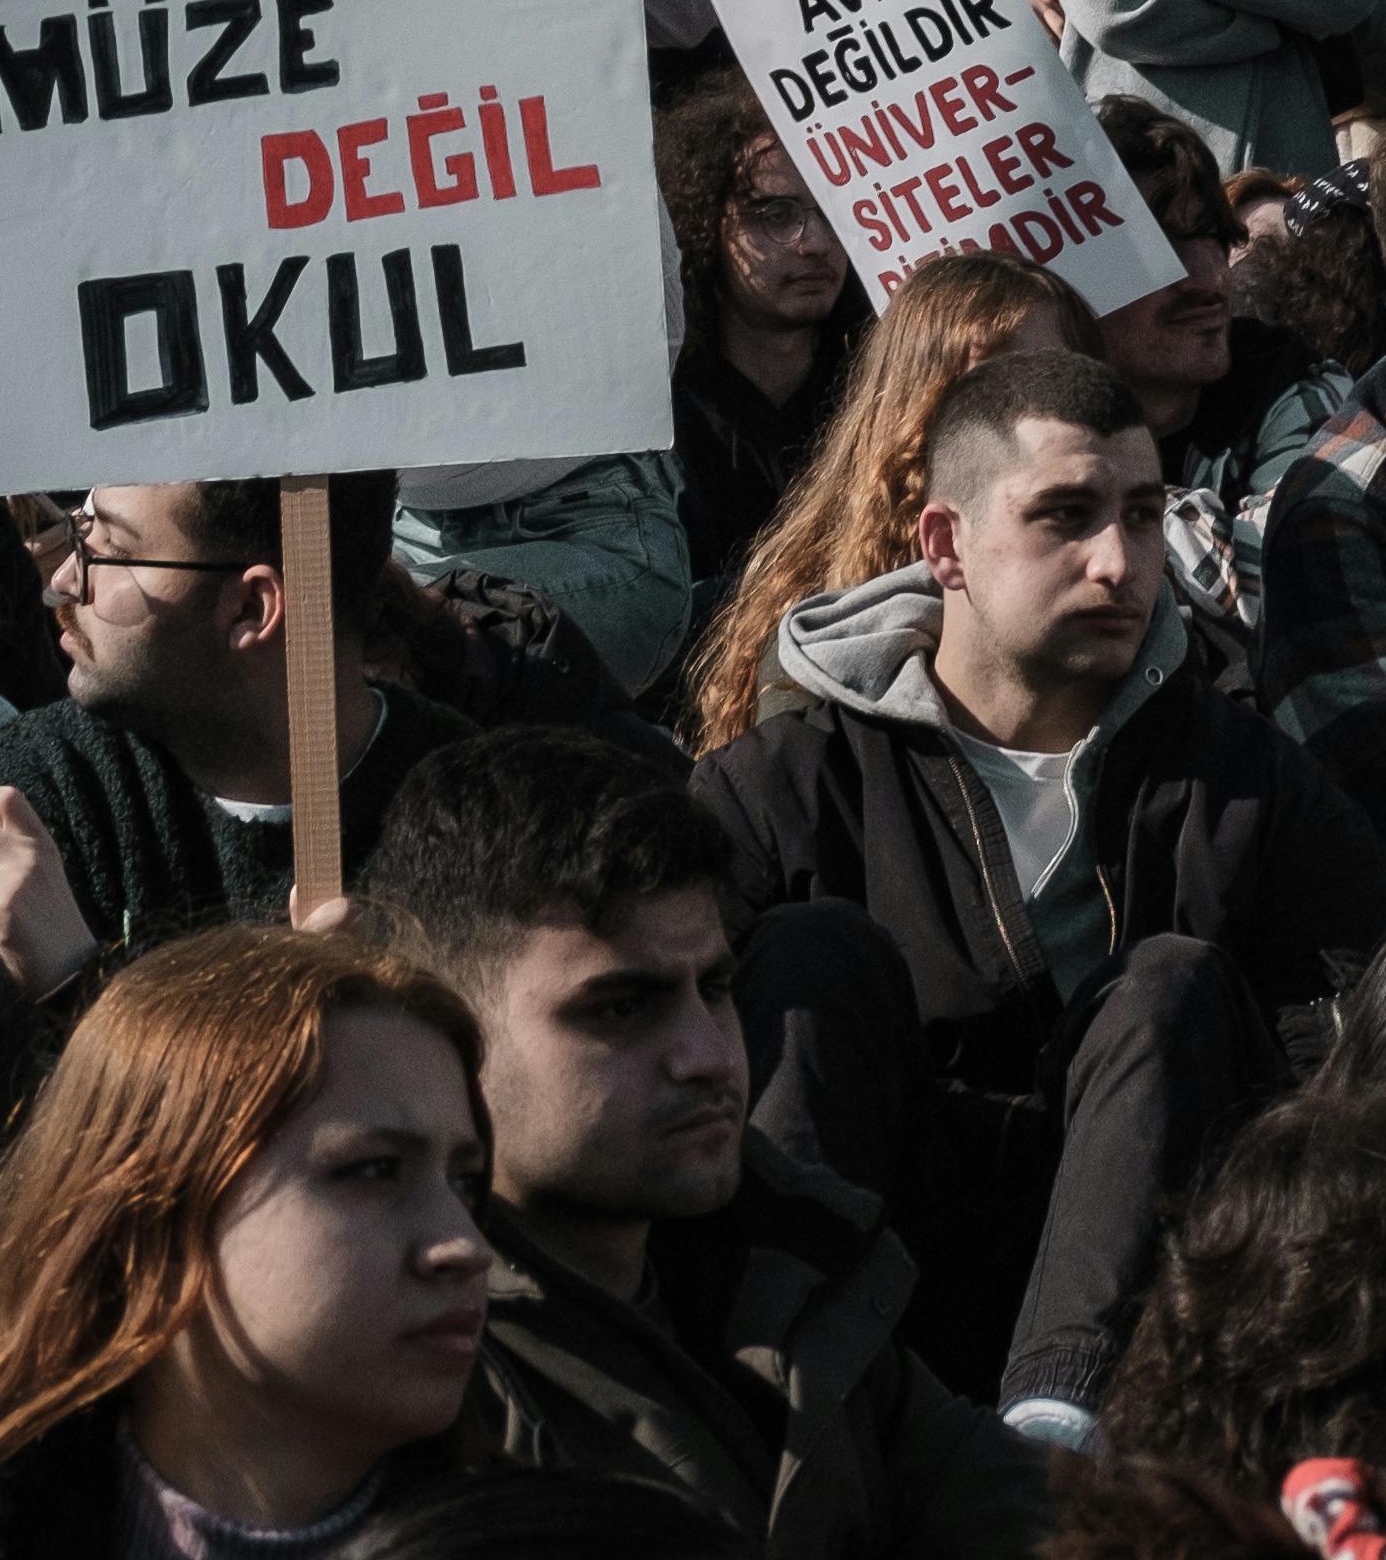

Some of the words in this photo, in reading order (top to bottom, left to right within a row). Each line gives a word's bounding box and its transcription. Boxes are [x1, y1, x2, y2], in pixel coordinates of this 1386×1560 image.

[261, 85, 601, 230] DEĞİL
[806, 65, 1036, 187] ÜNİVER-
[852, 122, 1075, 252] SİTELER
[78, 243, 527, 431] OKUL
